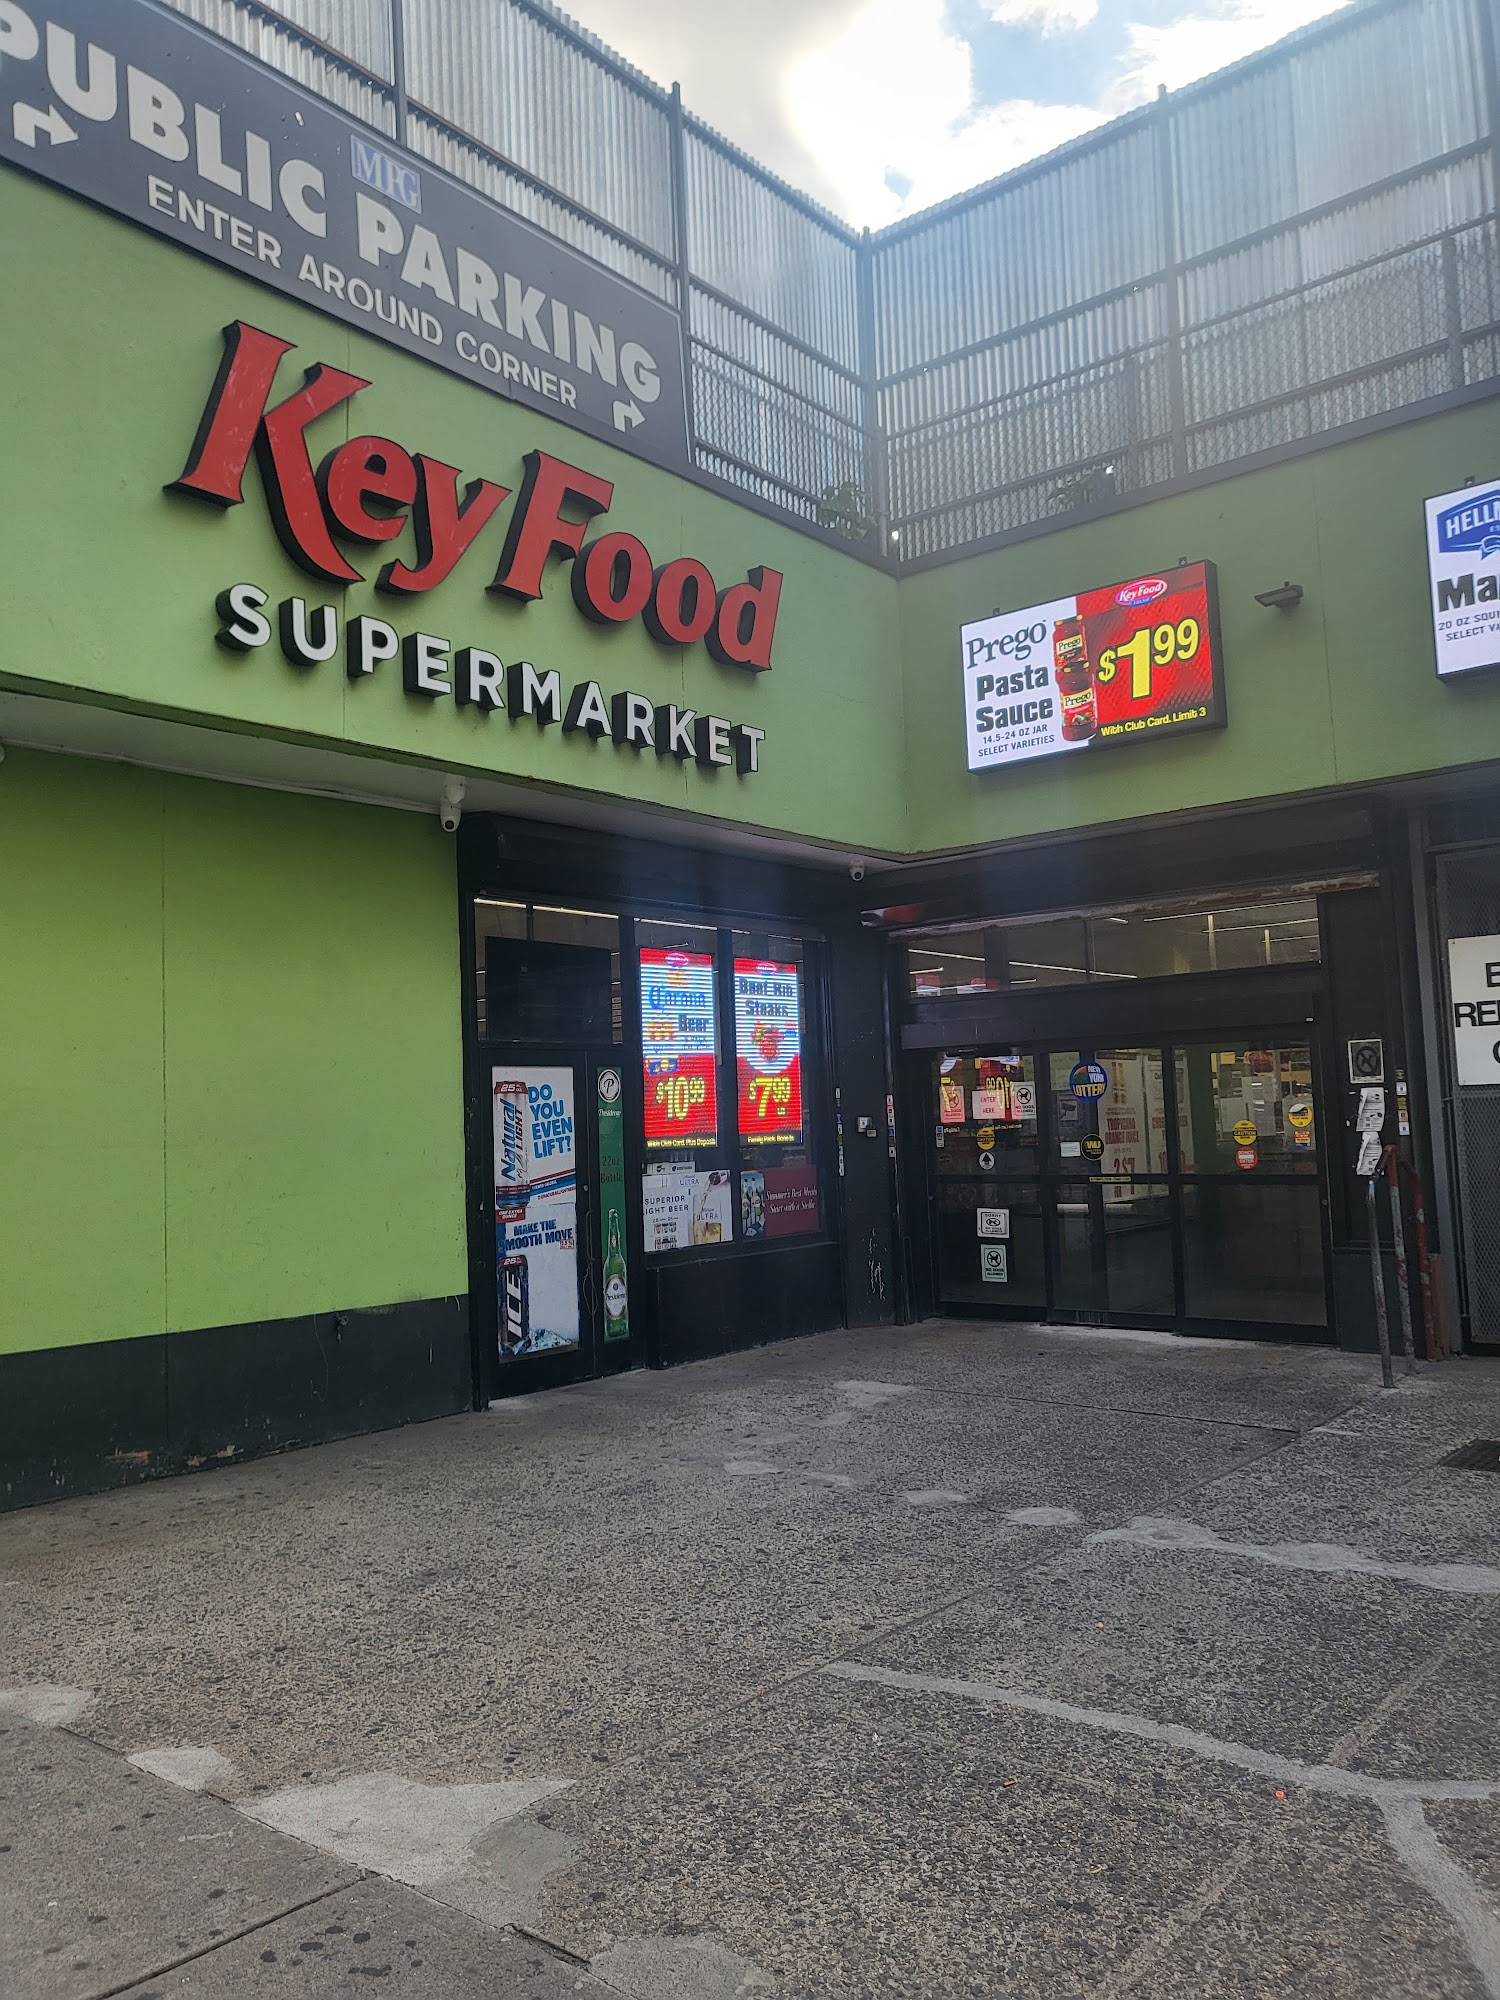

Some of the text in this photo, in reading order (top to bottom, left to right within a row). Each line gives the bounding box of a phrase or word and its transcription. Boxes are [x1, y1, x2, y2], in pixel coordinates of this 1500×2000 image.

[148, 173, 578, 410] ENTER AROUND CORNER
[356, 191, 662, 403] PARKING
[163, 319, 785, 673] Key Food
[1119, 588, 1138, 603] Key
[1137, 580, 1163, 597] Food
[1437, 573, 1500, 613] Ma
[1456, 616, 1470, 627] OZ
[1058, 637, 1081, 652] Prego
[1446, 626, 1486, 642] SELECT
[966, 621, 1047, 670] Prego
[217, 582, 767, 773] SUPERMARKET
[976, 664, 1049, 702] Pasta
[1065, 691, 1091, 707] Prego
[975, 697, 1053, 733] Sauce
[1100, 706, 1207, 737] With Club Card. Limit 3
[983, 723, 1048, 744] 14.5-24 OZ JAR
[978, 734, 1055, 757] SELECT VARIETIES
[738, 977, 794, 996] Beef Rib
[745, 1000, 789, 1017] Steaks
[1454, 1000, 1500, 1027] RE
[678, 1014, 710, 1032] Beer
[1087, 1064, 1101, 1074] NEW
[1088, 1073, 1105, 1083] YORK
[500, 1083, 515, 1093] 25
[528, 1083, 553, 1104] DO
[1072, 1083, 1106, 1097] LOTTERY
[530, 1099, 565, 1121] YOU
[515, 1105, 524, 1151] LIGHT
[531, 1116, 573, 1141] EVEN
[499, 1097, 516, 1182] Natural
[533, 1135, 572, 1159] LIFT?
[601, 1172, 623, 1184] Bottle
[643, 1204, 689, 1216] IGHT BEER
[644, 1194, 685, 1205] SUPERIOR
[696, 1212, 719, 1221] ULTRA
[513, 1219, 557, 1237] MAKE THE
[544, 1227, 574, 1245] MOVE
[505, 1269, 523, 1340] ICE
